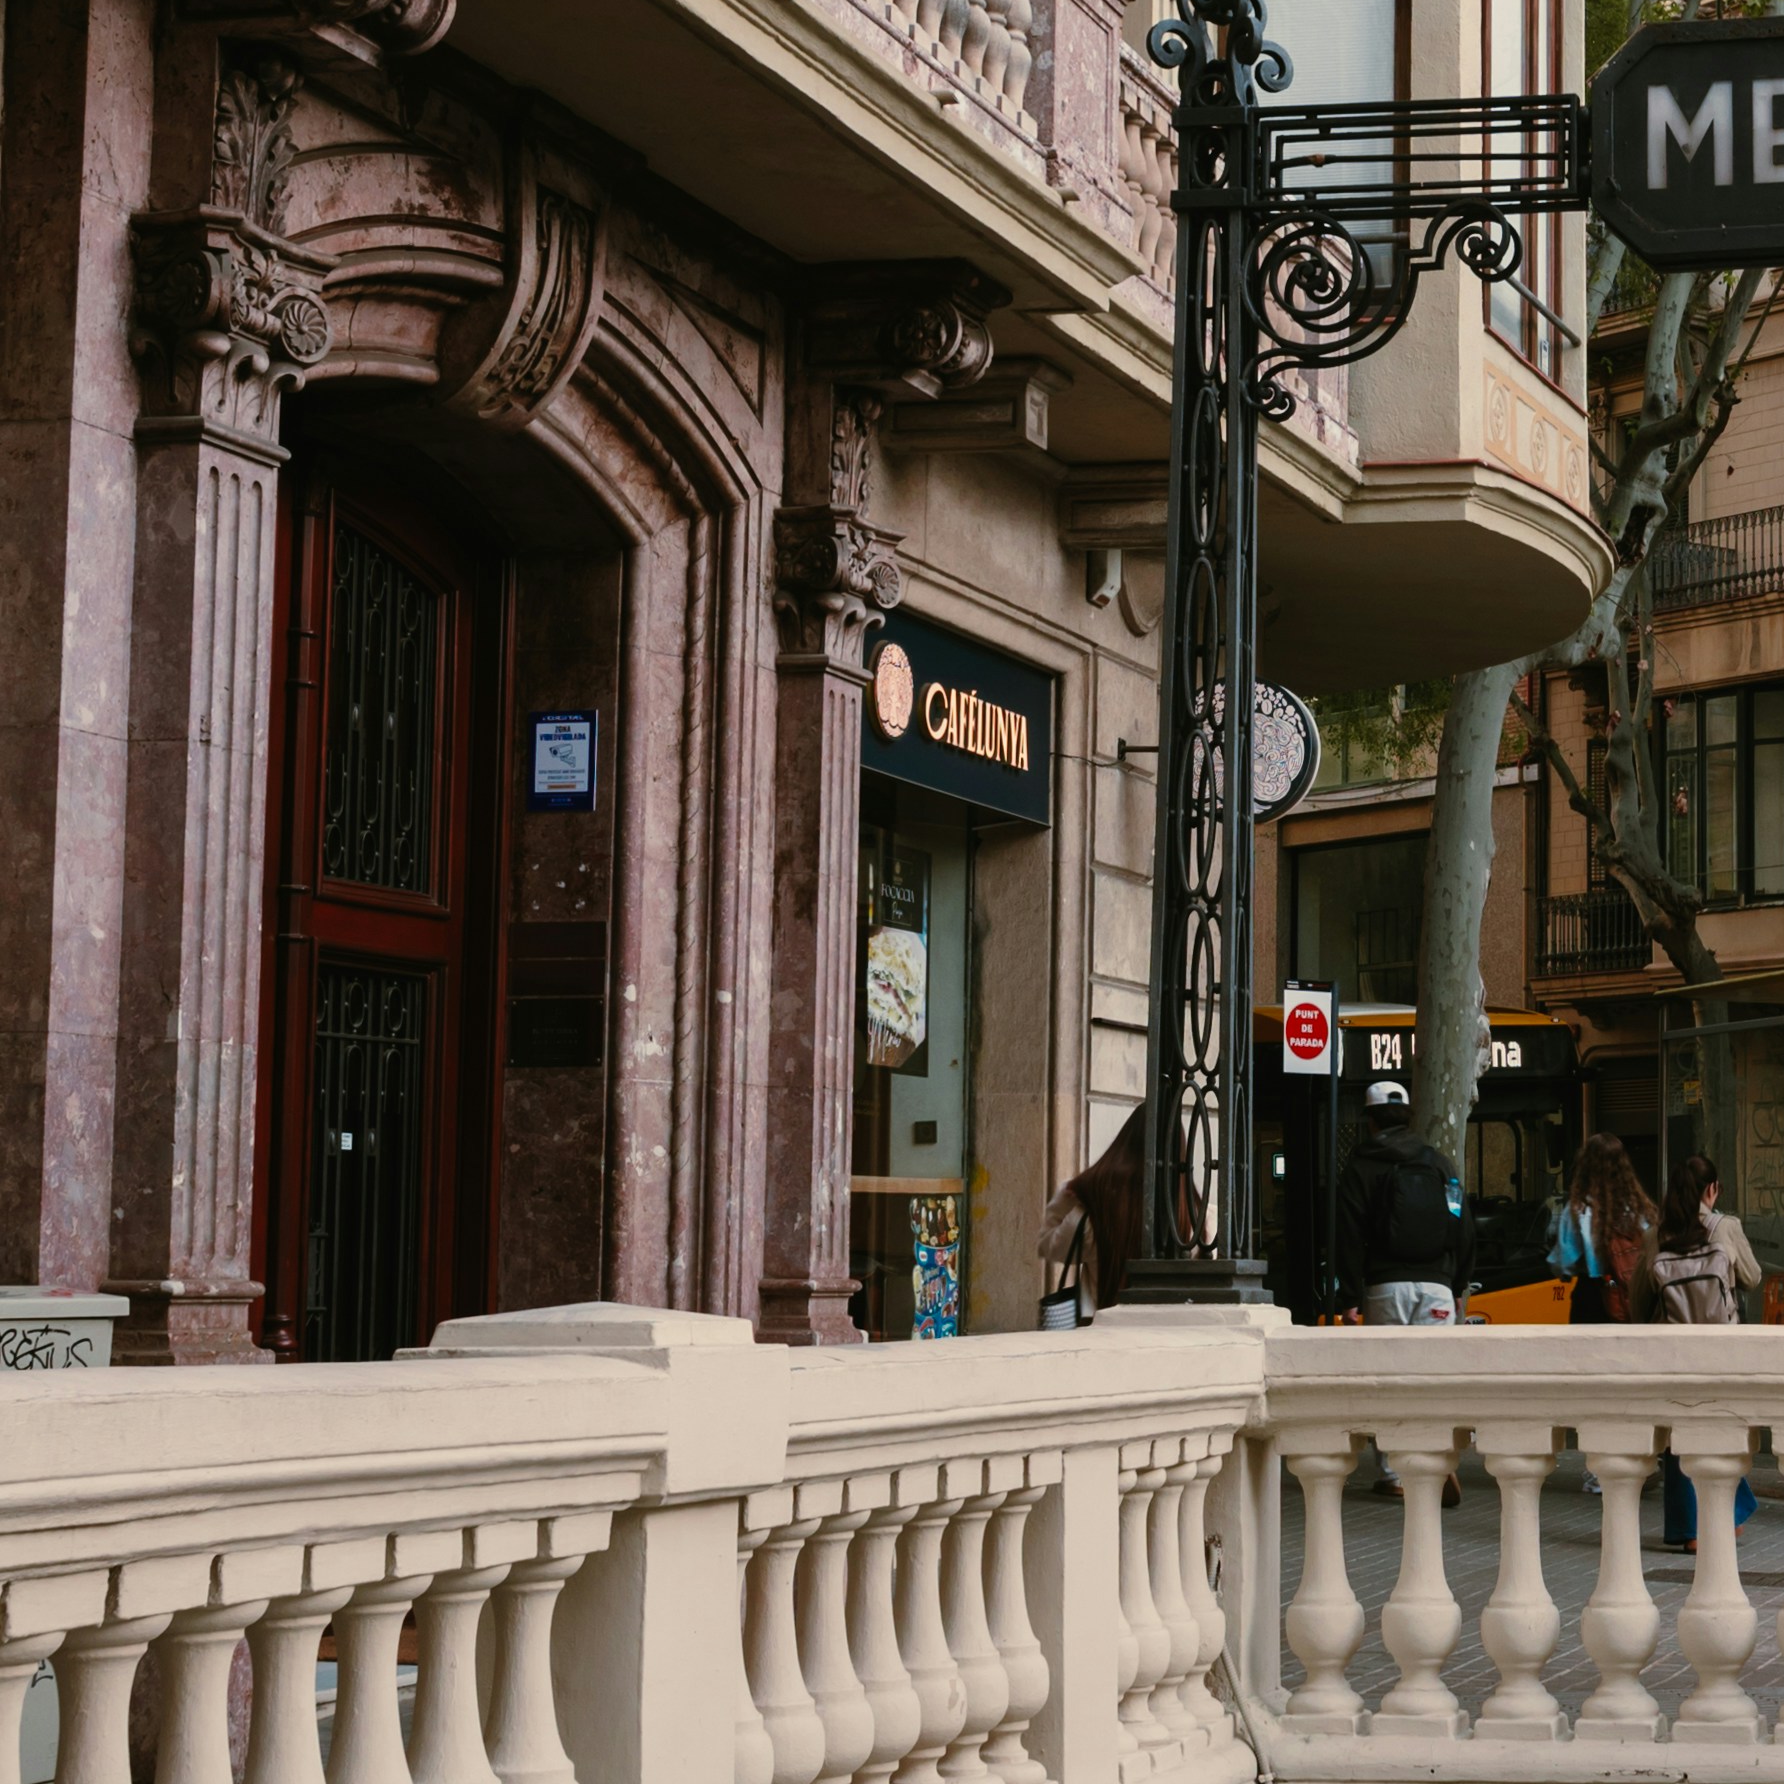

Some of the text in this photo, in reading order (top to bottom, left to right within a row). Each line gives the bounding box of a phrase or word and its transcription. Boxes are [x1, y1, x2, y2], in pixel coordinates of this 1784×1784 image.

[925, 681, 1029, 772] CAFÉLUNYA
[1295, 1009, 1320, 1020] PUNT
[1301, 1023, 1314, 1033] DE
[1289, 1036, 1324, 1048] PARADA
[1370, 1033, 1402, 1070] B24
